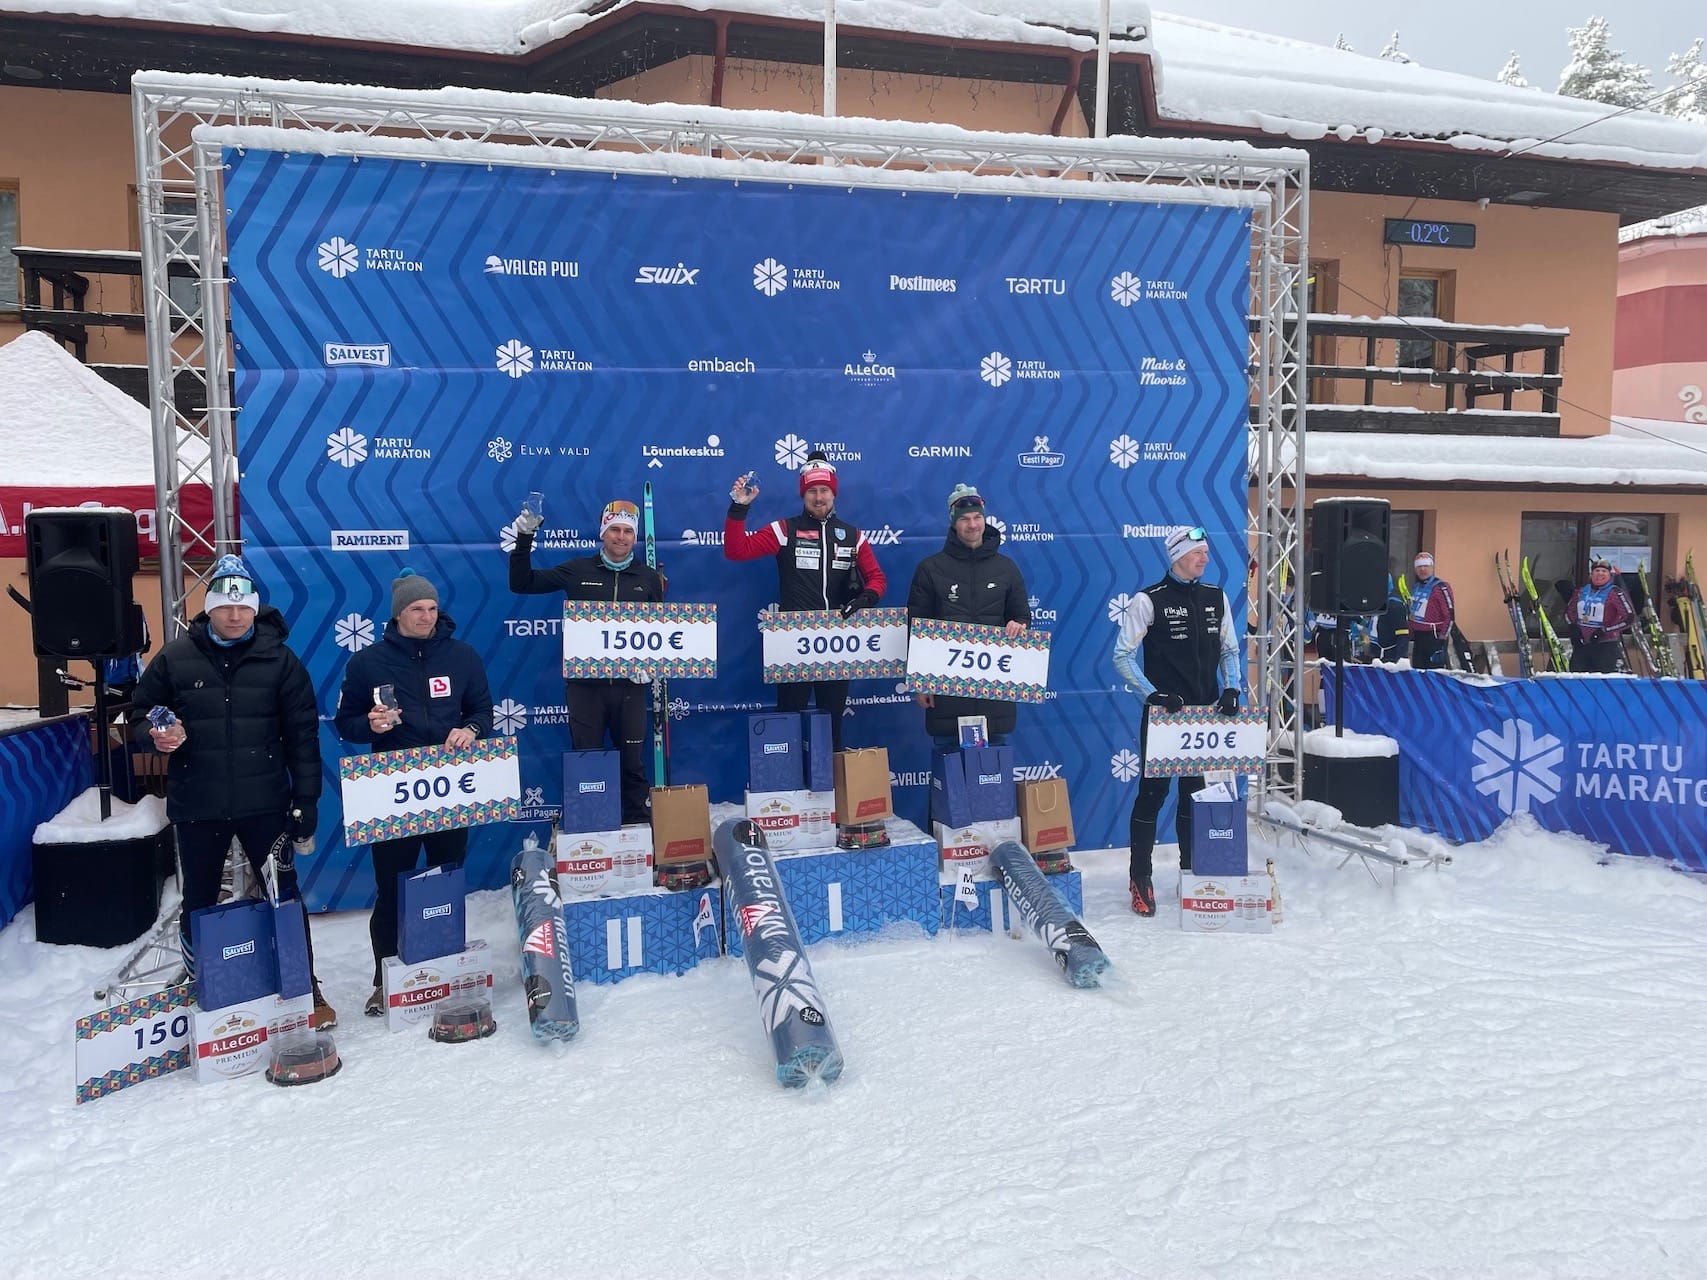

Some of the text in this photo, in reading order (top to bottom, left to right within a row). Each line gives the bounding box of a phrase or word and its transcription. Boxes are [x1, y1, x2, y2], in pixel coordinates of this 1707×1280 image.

[366, 249, 404, 260] TARTU
[366, 260, 423, 272] MARATON
[504, 259, 579, 277] VALGA PUU
[793, 269, 825, 279] TARTU
[793, 279, 840, 290] MARATON
[890, 275, 957, 293] Postimees
[1146, 280, 1175, 290] TARTU
[1146, 289, 1188, 300] MARATON
[329, 347, 385, 362] SALVEST
[540, 350, 575, 360] TARTU
[540, 360, 592, 371] MARATON
[688, 357, 755, 373] embach
[1016, 361, 1045, 370] TARTU
[1141, 357, 1186, 371] Maks &
[1016, 369, 1060, 379] MARATON
[1140, 372, 1186, 386] Moorits
[375, 438, 412, 448] TARTU
[814, 442, 845, 452] TARTU
[1144, 443, 1172, 452] TARTU
[375, 448, 431, 459] MARATON
[643, 445, 725, 457] Lõunakeskus
[823, 451, 861, 462] ARATON
[908, 446, 972, 457] GARMIN
[1144, 451, 1187, 462] MARATON
[544, 529, 579, 539] TARTU
[861, 524, 904, 545] wix
[1011, 524, 1040, 533] TARTU
[1123, 524, 1178, 539] Postime
[336, 535, 404, 547] RAMIRENT
[698, 531, 726, 545] VAL
[1011, 532, 1054, 542] MARATON
[544, 538, 596, 549] MARATON
[601, 630, 684, 650] 1500 €
[797, 634, 881, 655] 3000 €
[947, 649, 1012, 674] 750 €
[533, 705, 568, 715] TARTU
[533, 715, 569, 725] MARAT
[1181, 731, 1237, 749] 250 €
[1578, 743, 1683, 771] TARTU
[394, 772, 476, 804] 500 €
[1575, 773, 1707, 808] MARATO
[543, 921, 553, 956] VALLEY
[224, 942, 254, 959] SALVEST
[553, 916, 575, 999] Maraton
[404, 1002, 441, 1015] PREMIU
[134, 1015, 189, 1050] 150
